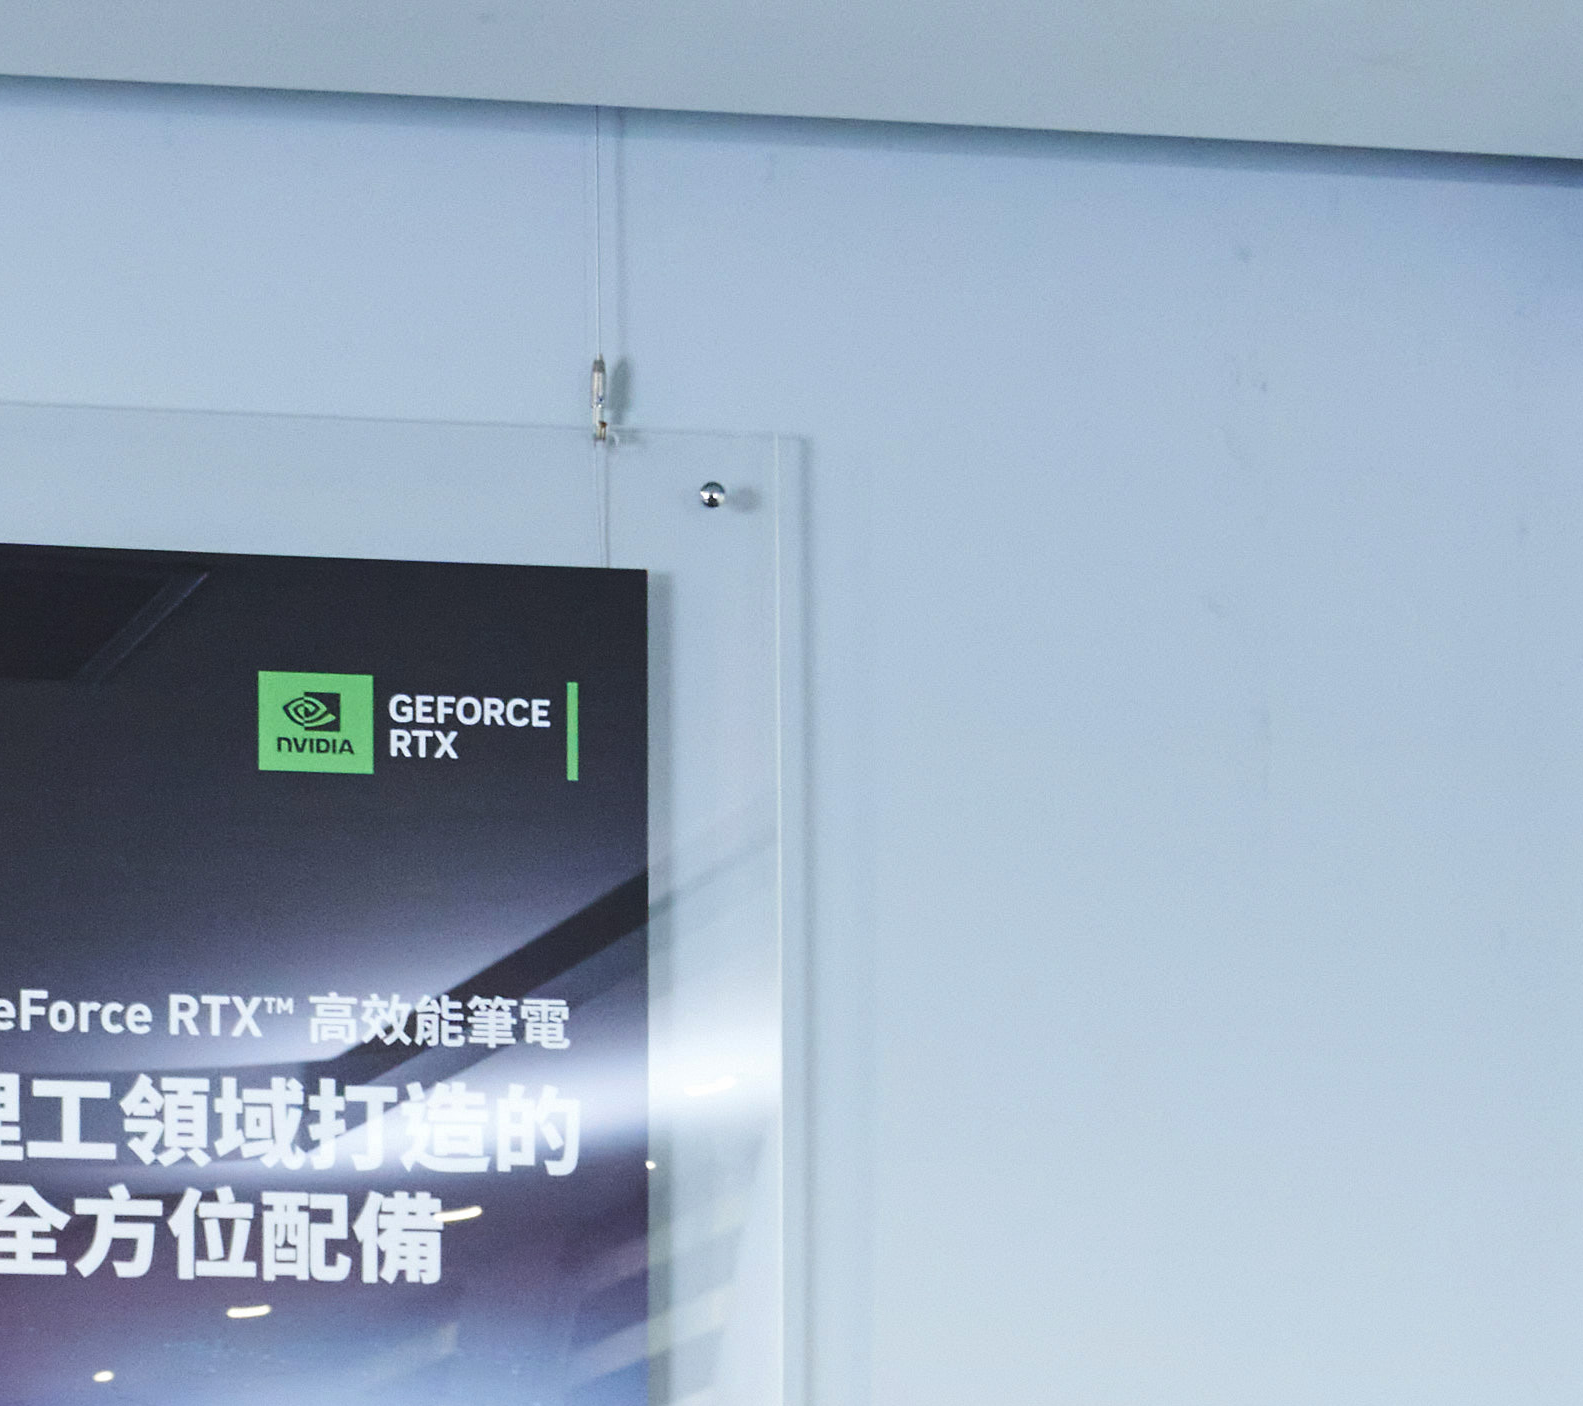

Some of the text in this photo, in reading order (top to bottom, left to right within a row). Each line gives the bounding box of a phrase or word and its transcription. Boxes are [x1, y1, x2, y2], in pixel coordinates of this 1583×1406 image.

[388, 693, 551, 729] GEFORCE
[276, 736, 355, 756] NVIDIA
[388, 727, 459, 760] RTX
[308, 991, 571, 1049] 高效能筆電
